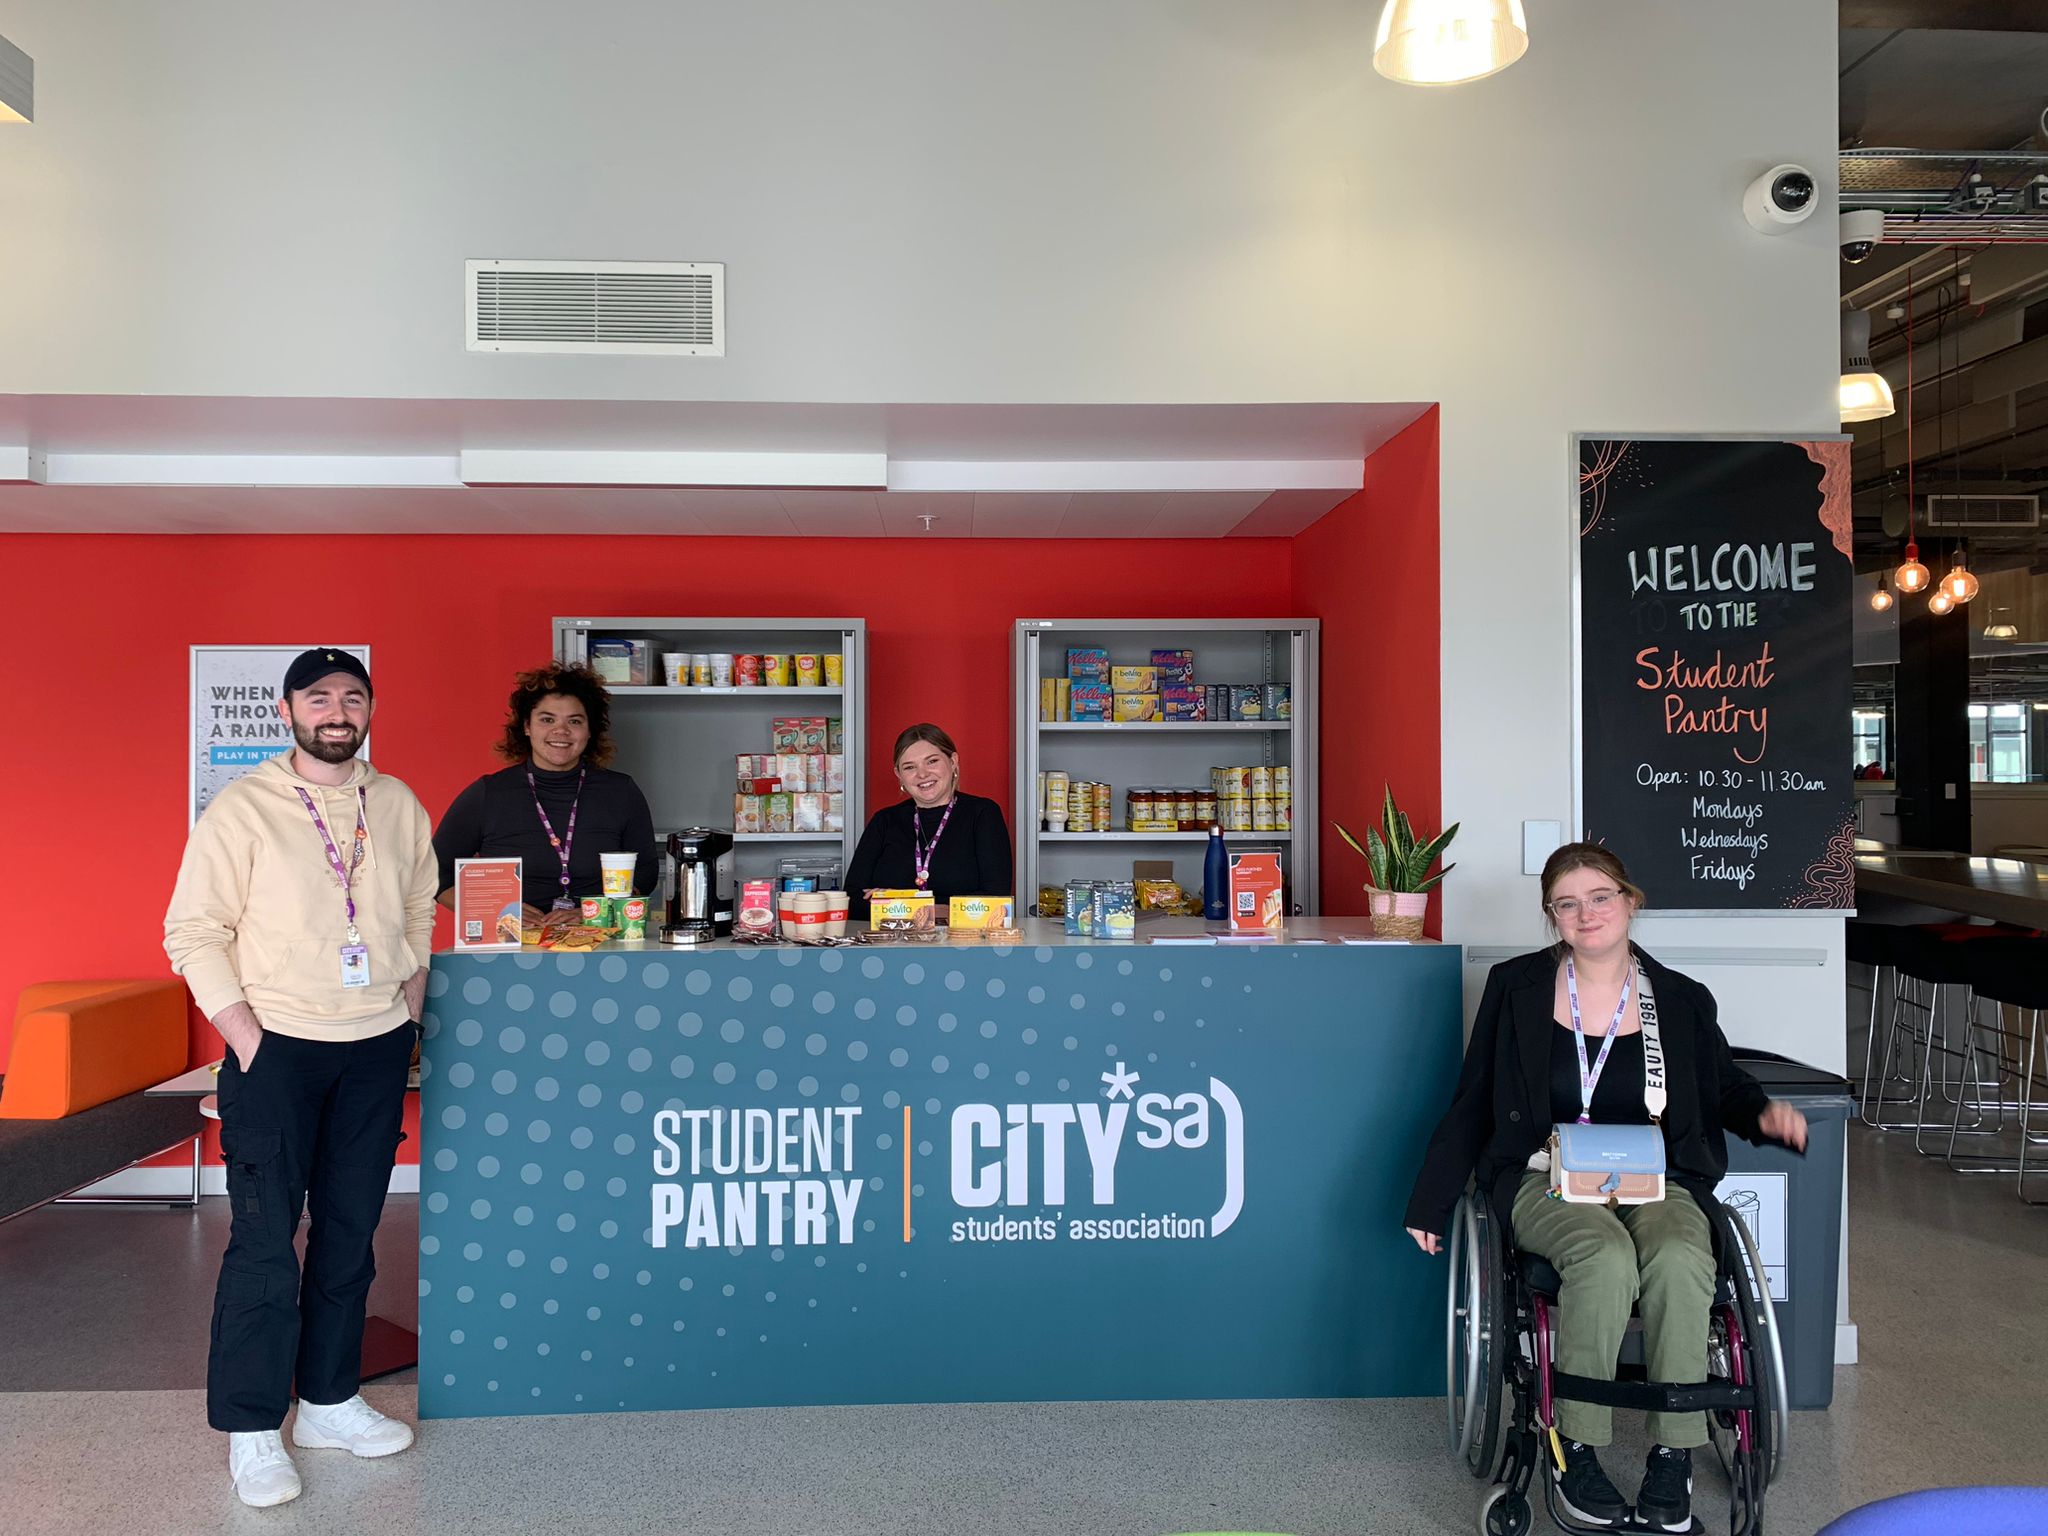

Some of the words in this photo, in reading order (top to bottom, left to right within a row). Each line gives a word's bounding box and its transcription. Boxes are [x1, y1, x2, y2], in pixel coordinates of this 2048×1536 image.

[1628, 542, 1817, 593] WELCOME
[1680, 602, 1713, 631] TO
[1716, 600, 1758, 628] THE
[1635, 641, 1775, 690] Student
[211, 686, 274, 700] WHEN
[210, 724, 224, 737] A
[231, 724, 292, 737] RAINY
[1665, 694, 1768, 764] Pantry
[1636, 763, 1689, 792] Open:
[1693, 796, 1763, 828] Mondays
[1681, 827, 1769, 859] Wednesdays
[1691, 854, 1755, 890] Fridays
[882, 903, 912, 914] belVita
[960, 902, 990, 912] belVita
[1639, 992, 1657, 1026] 1987
[653, 1106, 863, 1176] STUDENT
[652, 1179, 864, 1248] PANTRY
[952, 1211, 1062, 1241] students'
[1069, 1212, 1205, 1239] association
